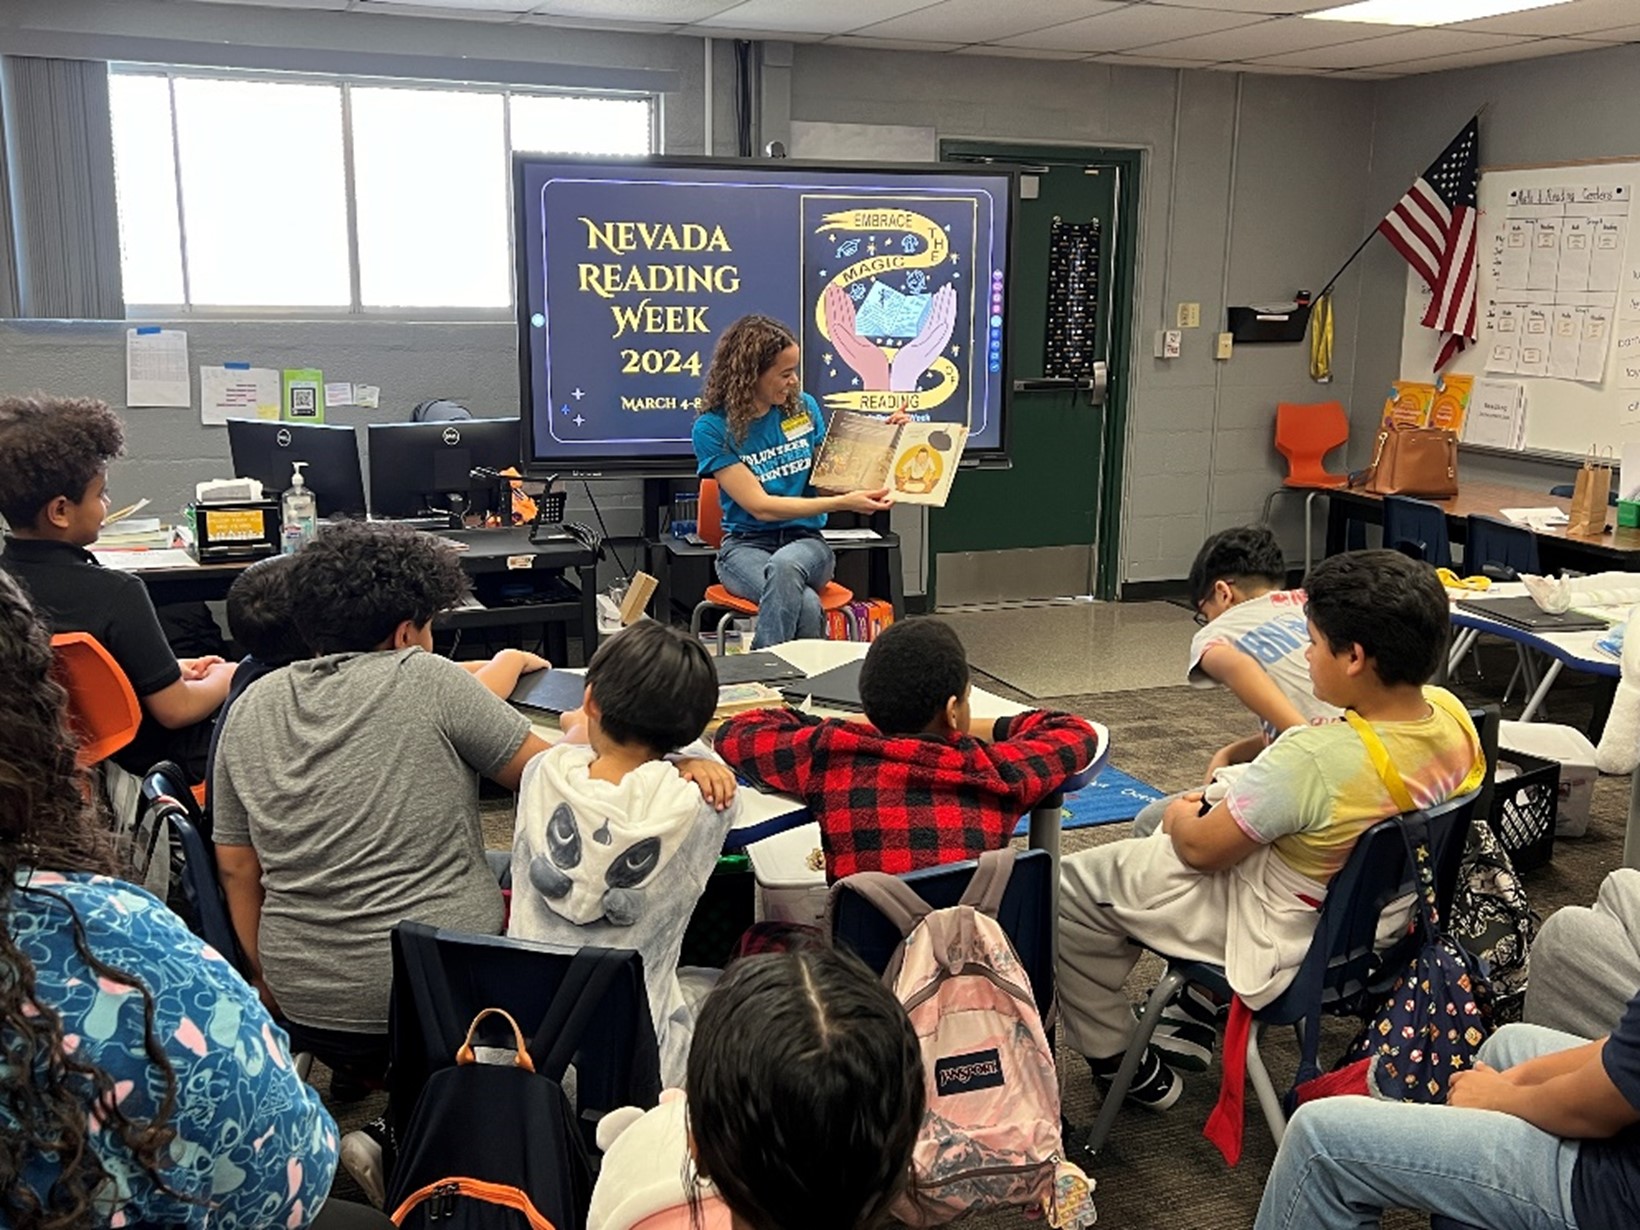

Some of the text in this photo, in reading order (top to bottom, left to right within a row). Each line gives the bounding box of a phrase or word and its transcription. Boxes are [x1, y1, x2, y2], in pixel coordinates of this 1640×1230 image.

[854, 212, 913, 229] EMBRACE
[577, 217, 732, 256] NEVADA
[928, 227, 944, 262] THE
[577, 263, 741, 298] READING
[842, 256, 905, 283] MAGIC
[610, 298, 711, 339] WEEK
[620, 349, 703, 377] 2024
[620, 396, 677, 412] MARCH
[860, 394, 920, 409] READING
[940, 1060, 998, 1087] JANSPORT
